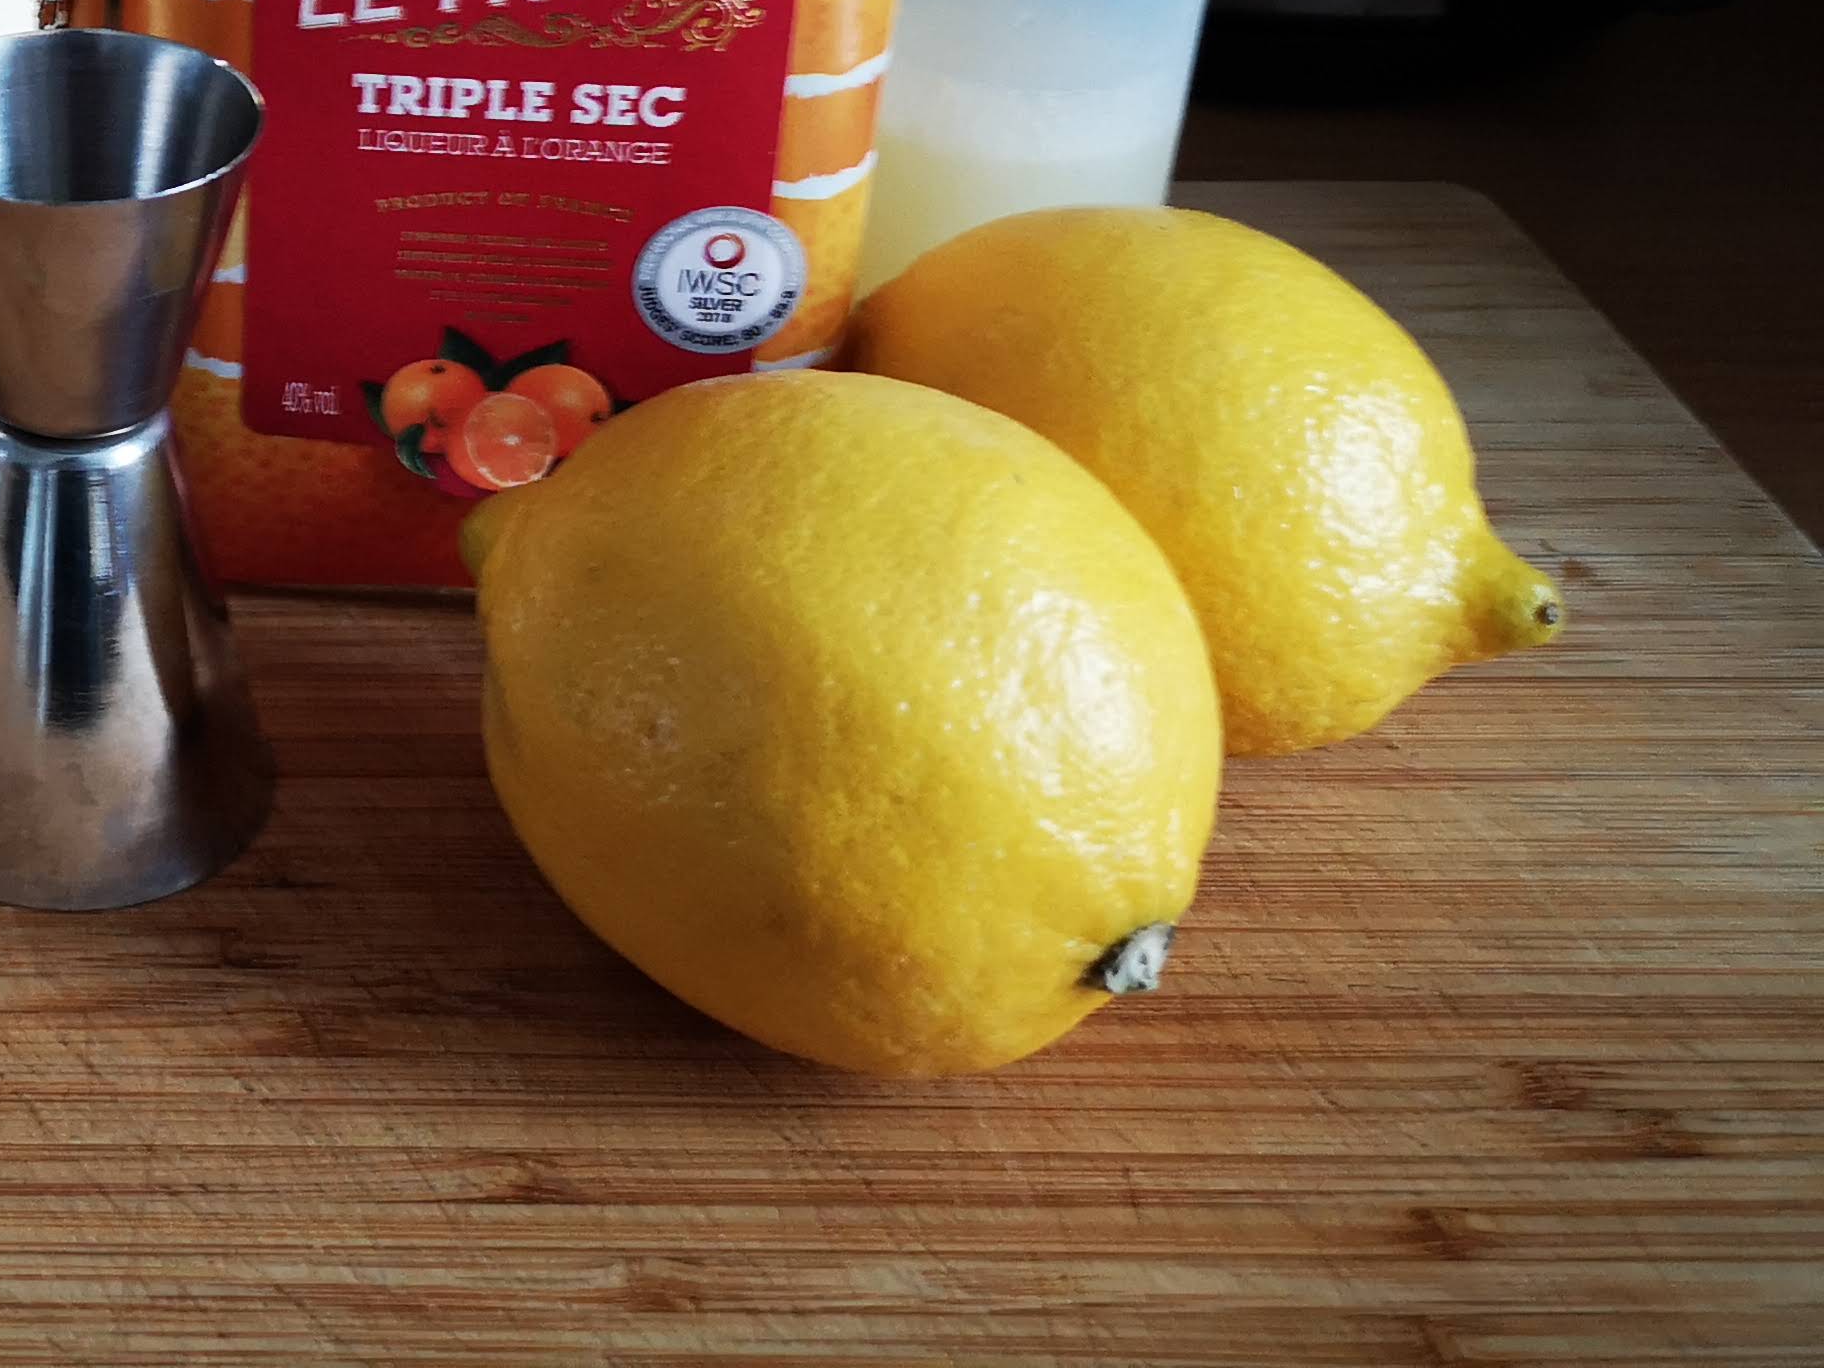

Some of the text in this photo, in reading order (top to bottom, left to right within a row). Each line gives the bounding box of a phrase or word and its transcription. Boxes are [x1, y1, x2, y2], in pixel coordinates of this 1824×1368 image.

[351, 72, 688, 128] TRIPLE SEC
[356, 128, 489, 157] LIQUEUR
[521, 136, 674, 165] L'ORANGE
[677, 269, 763, 297] IWSC
[687, 296, 744, 312] SILVER
